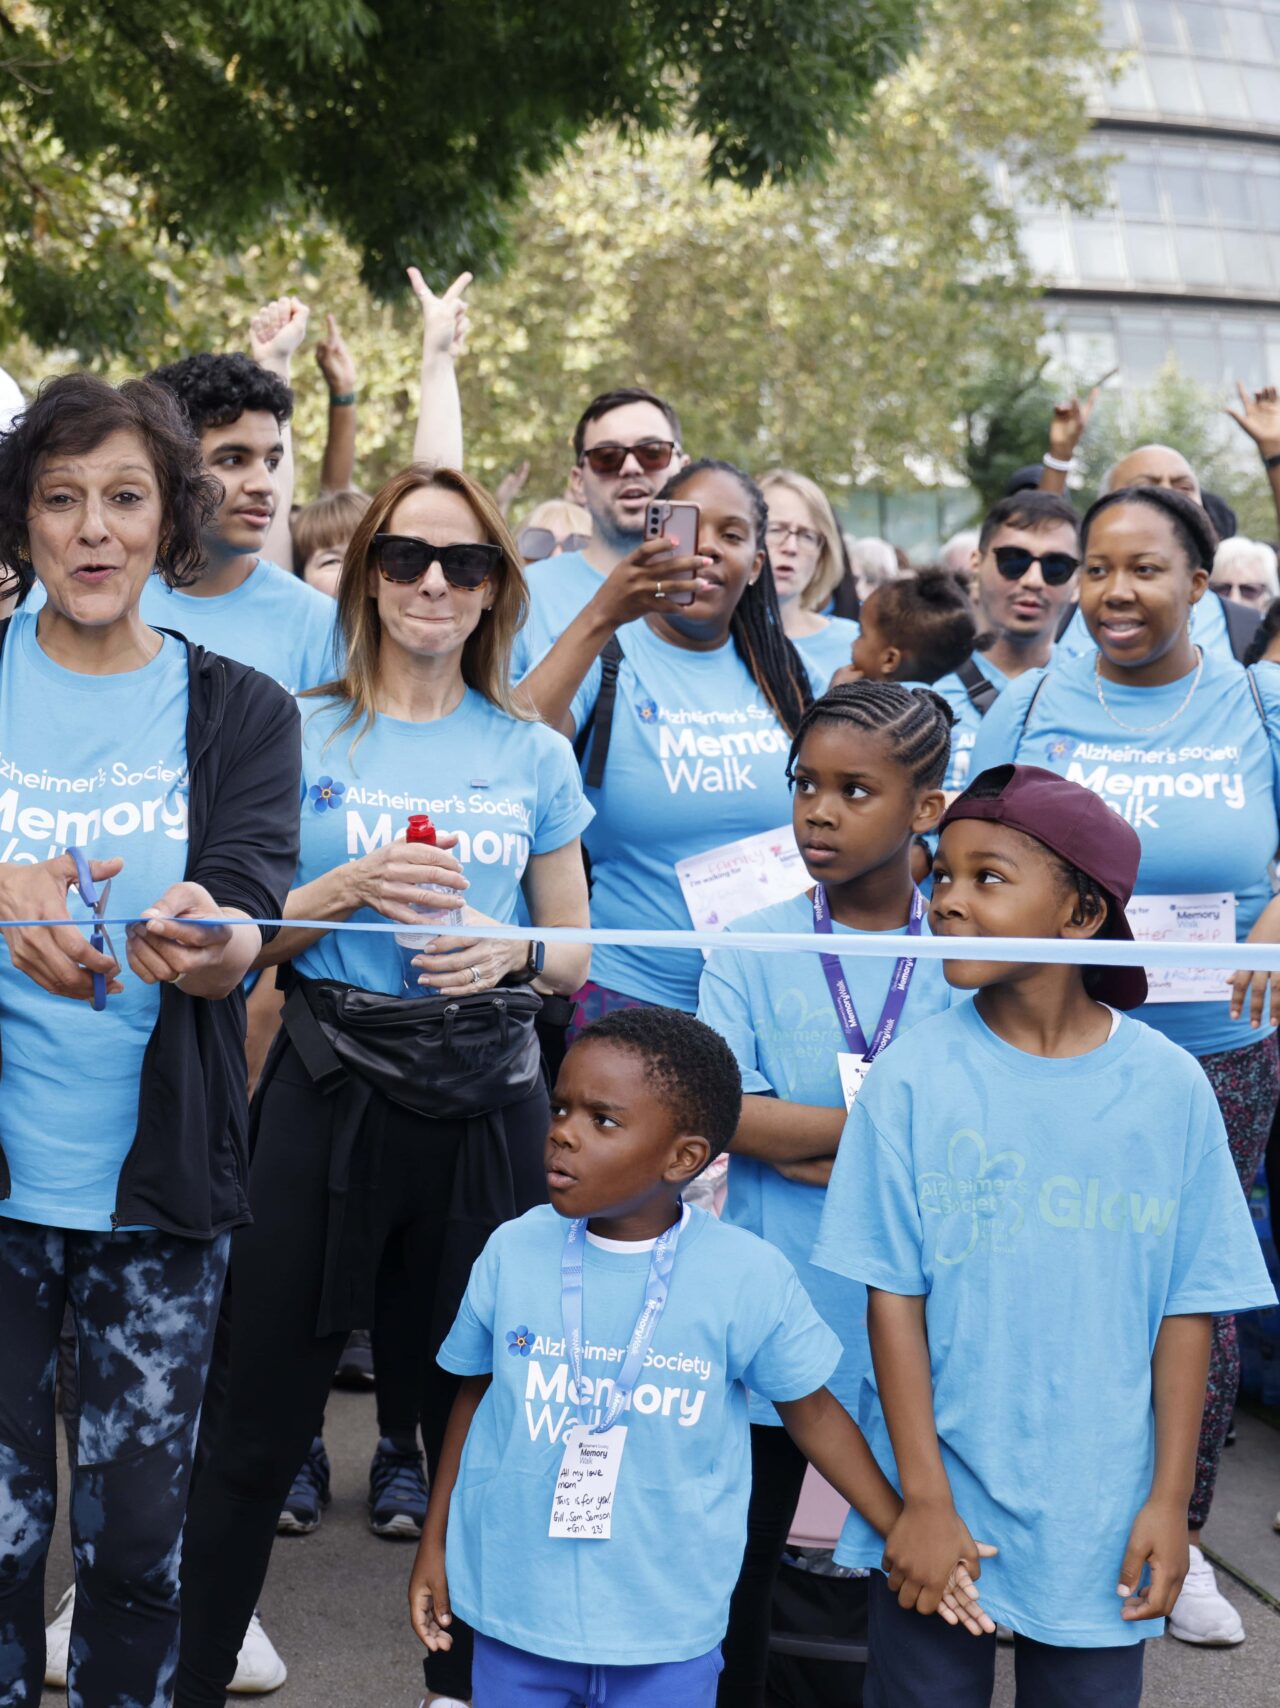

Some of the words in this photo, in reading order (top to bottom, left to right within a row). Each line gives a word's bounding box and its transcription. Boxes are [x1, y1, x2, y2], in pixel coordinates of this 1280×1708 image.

[658, 725, 789, 759] Memor
[1072, 742, 1177, 765] Alzheimer's
[661, 757, 757, 794] Walk
[1065, 761, 1246, 810] Memory
[345, 786, 466, 814] Alzheimer's
[346, 810, 530, 879] Mory
[1176, 911, 1220, 920] Memory
[641, 1347, 711, 1381] Society
[580, 1448, 608, 1459] Memory
[560, 1467, 570, 1478] All
[572, 1470, 584, 1482] my
[586, 1468, 604, 1477] love
[555, 1495, 570, 1506] This
[574, 1496, 581, 1506] is
[581, 1493, 594, 1507] for
